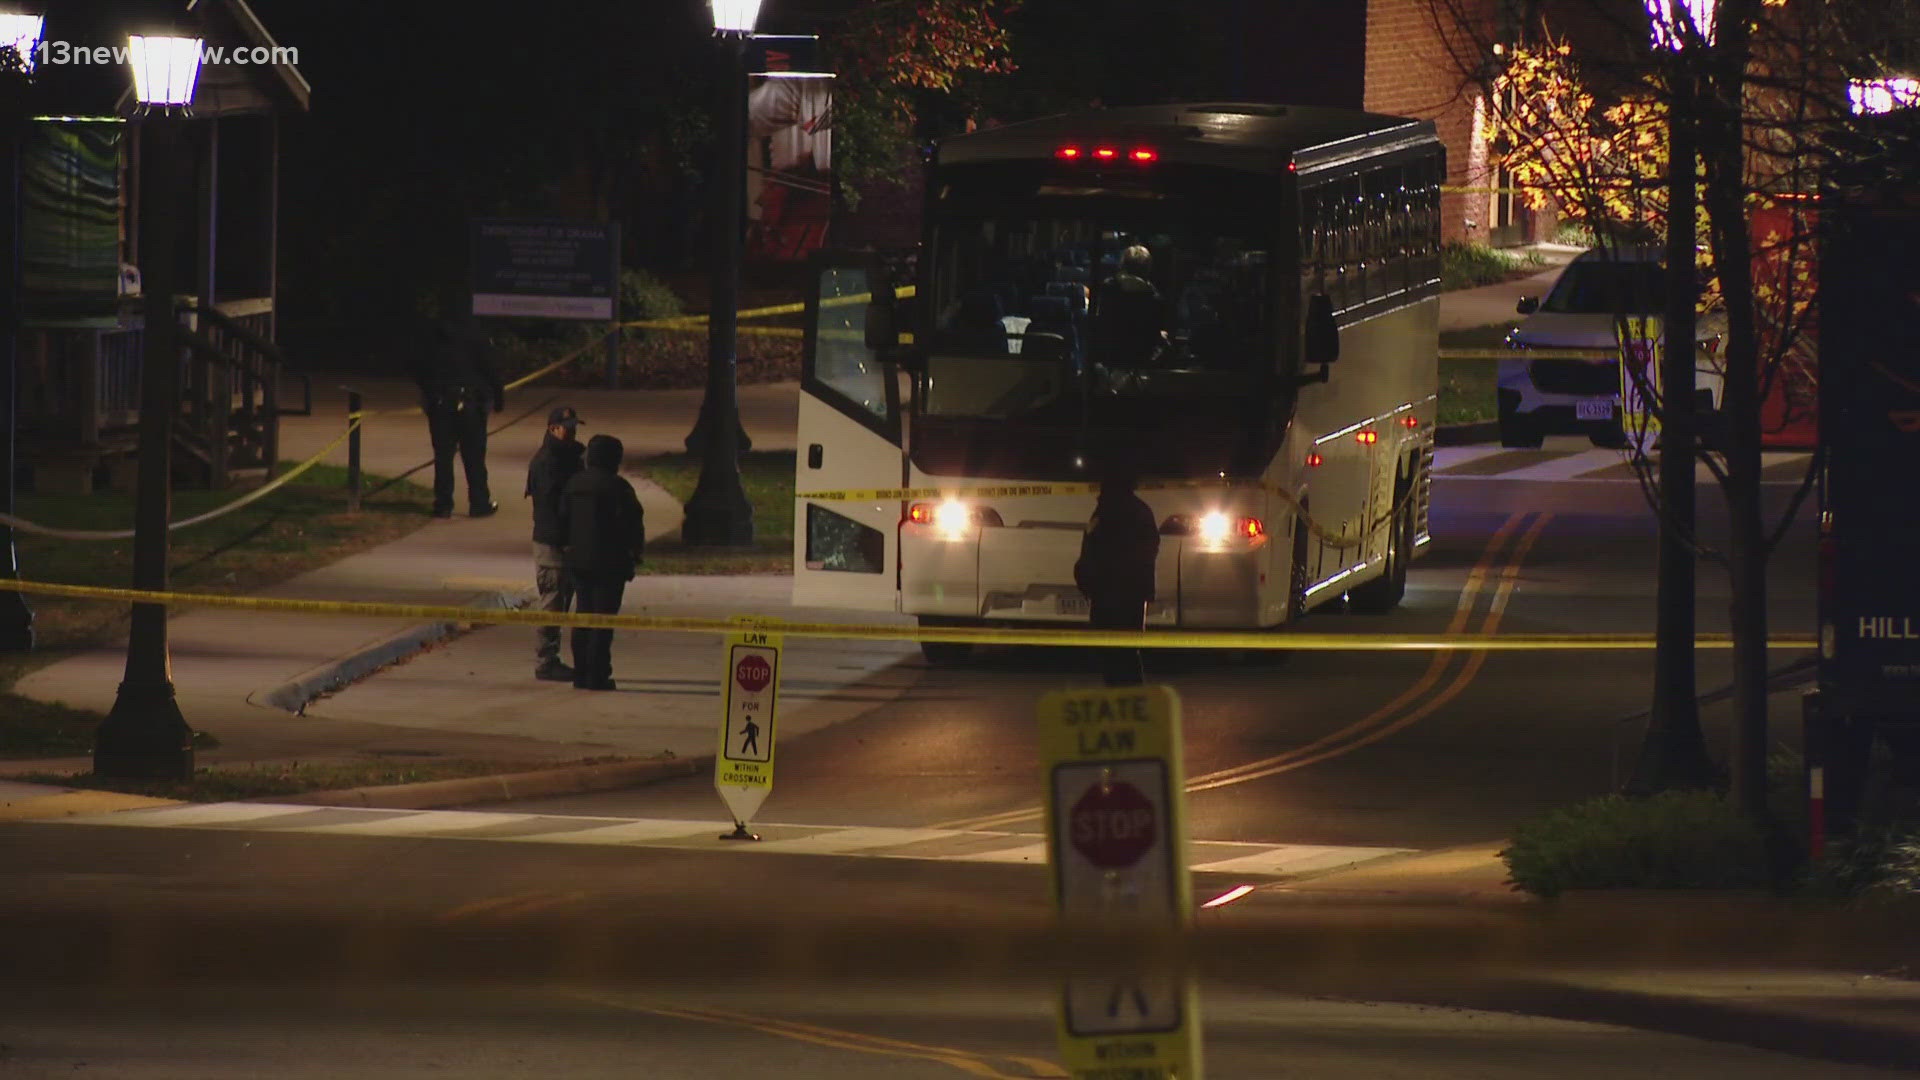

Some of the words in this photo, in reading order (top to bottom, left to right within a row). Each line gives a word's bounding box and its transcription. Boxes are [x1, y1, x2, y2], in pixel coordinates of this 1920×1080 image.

[1859, 616, 1919, 639] HILL
[744, 632, 768, 645] LAW
[737, 665, 769, 681] STOP
[742, 701, 760, 711] FOR
[1063, 696, 1149, 725] STATE
[1078, 728, 1136, 755] LAW
[735, 763, 759, 773] WITHIN
[723, 773, 767, 785] CROSSWALK
[1076, 811, 1152, 841] STOP
